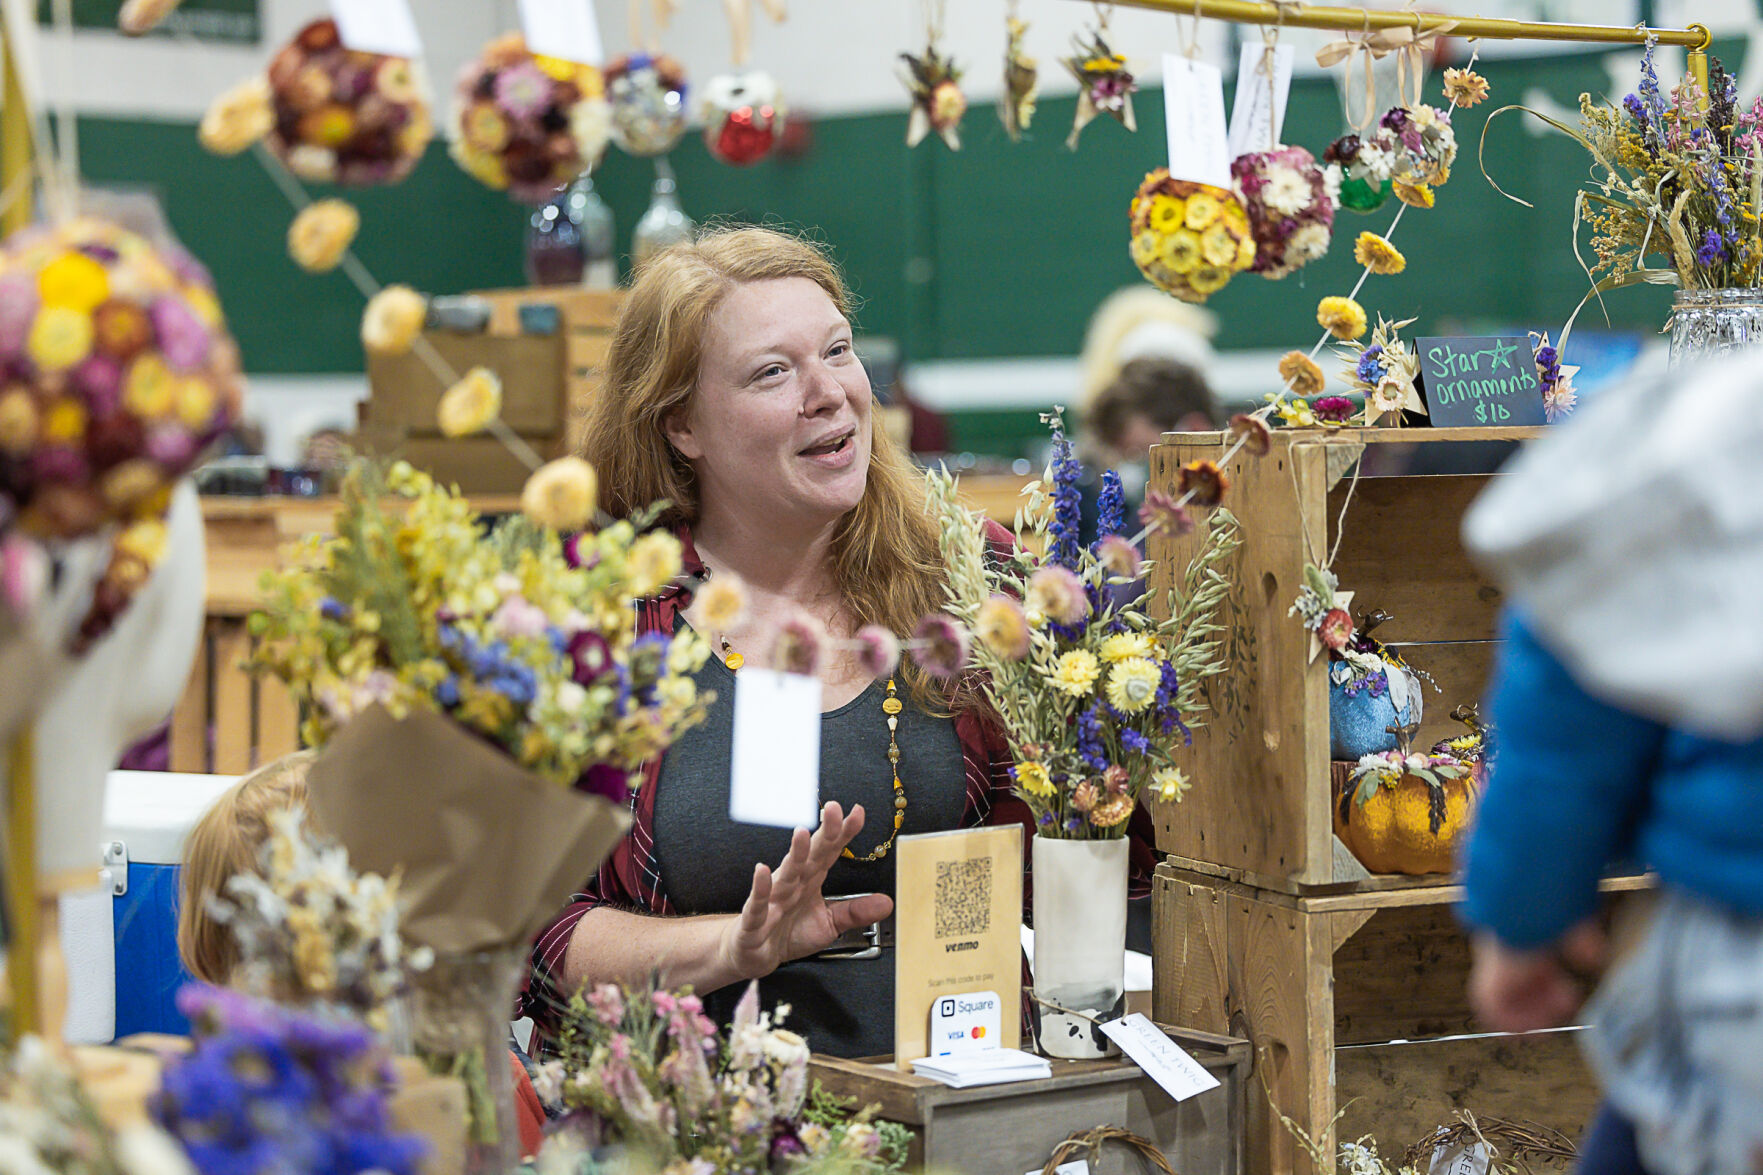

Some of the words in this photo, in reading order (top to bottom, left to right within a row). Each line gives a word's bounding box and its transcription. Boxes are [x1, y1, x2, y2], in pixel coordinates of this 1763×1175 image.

[1428, 345, 1480, 378] Star
[1436, 367, 1536, 405] ornaments
[1474, 399, 1511, 423] $10
[945, 940, 979, 953] venmo
[957, 999, 994, 1016] Square
[947, 1031, 965, 1040] VISA
